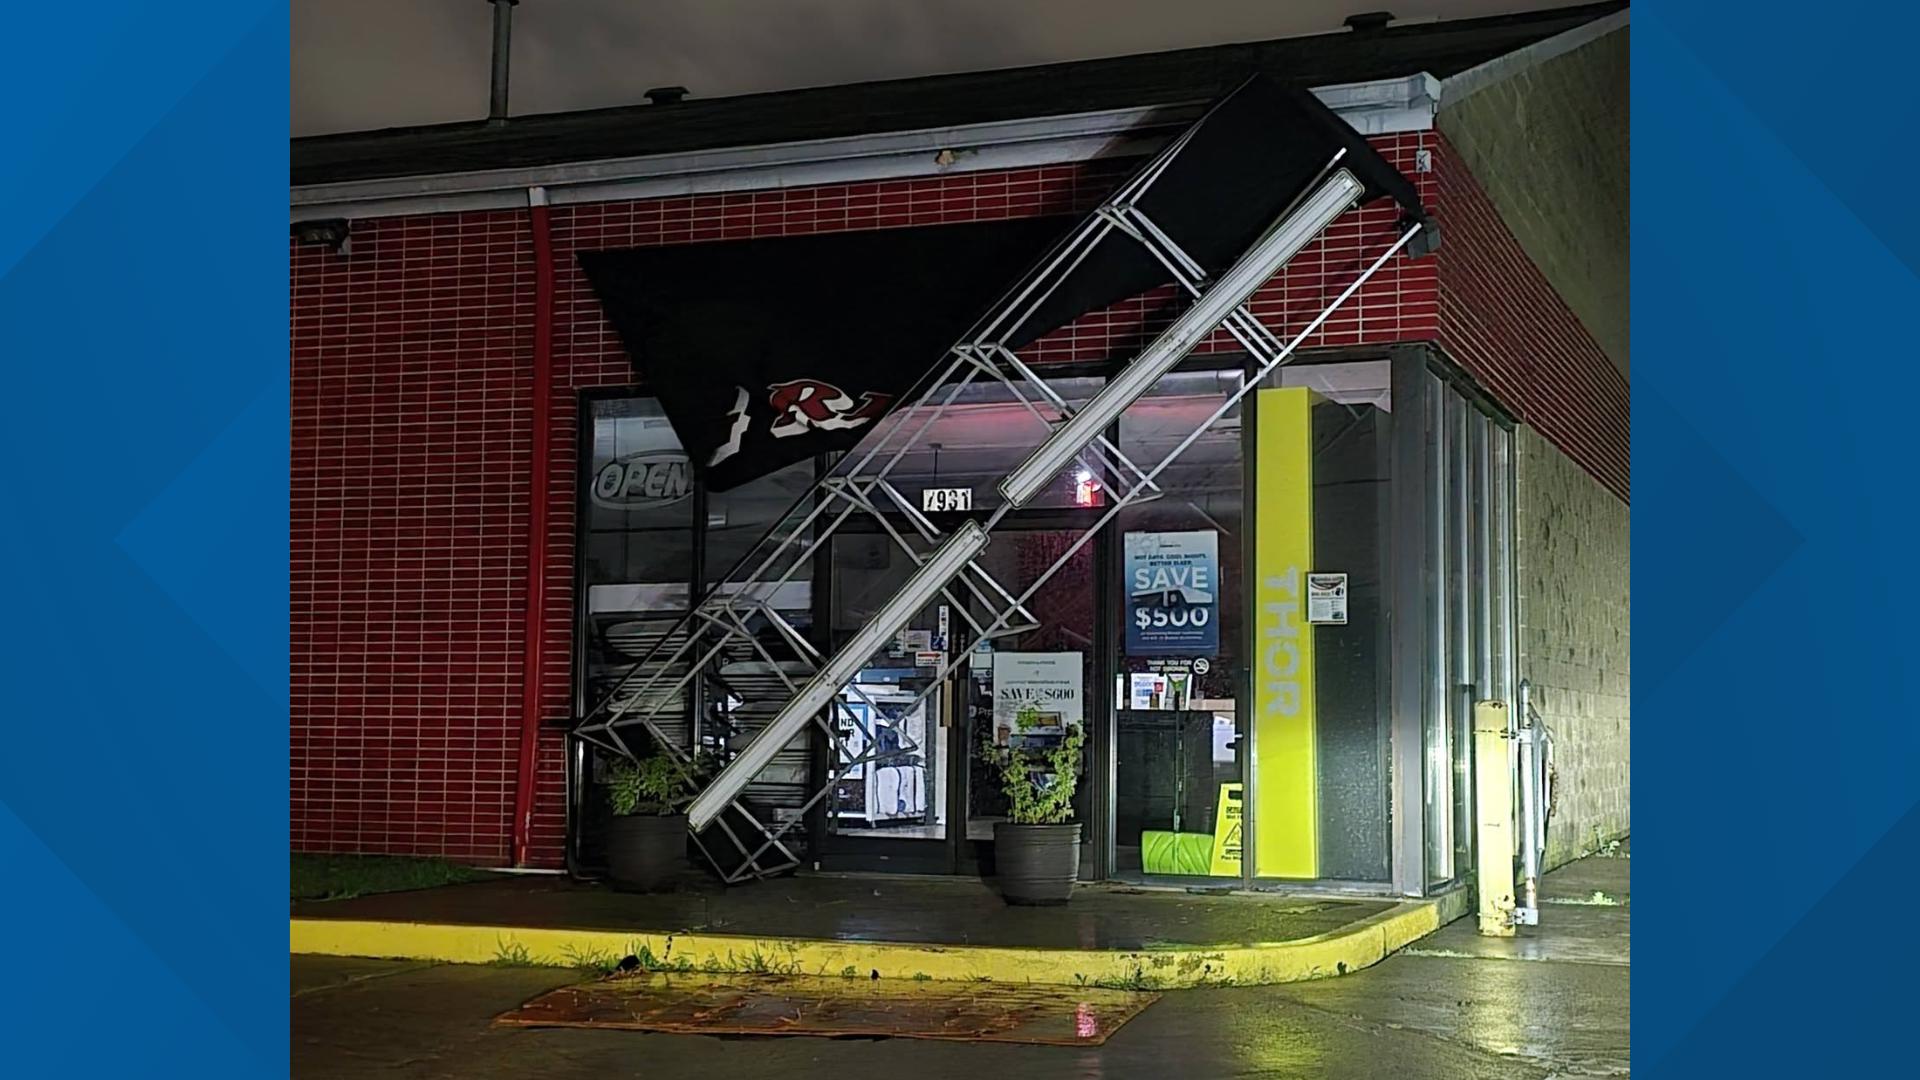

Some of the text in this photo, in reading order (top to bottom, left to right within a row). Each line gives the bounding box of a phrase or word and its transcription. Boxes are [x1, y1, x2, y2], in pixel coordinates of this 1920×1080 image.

[597, 461, 689, 499] OPEN
[1134, 566, 1209, 590] SAVE
[1135, 607, 1209, 630] $500
[1263, 565, 1300, 717] THOR
[1001, 687, 1035, 700] SAVE
